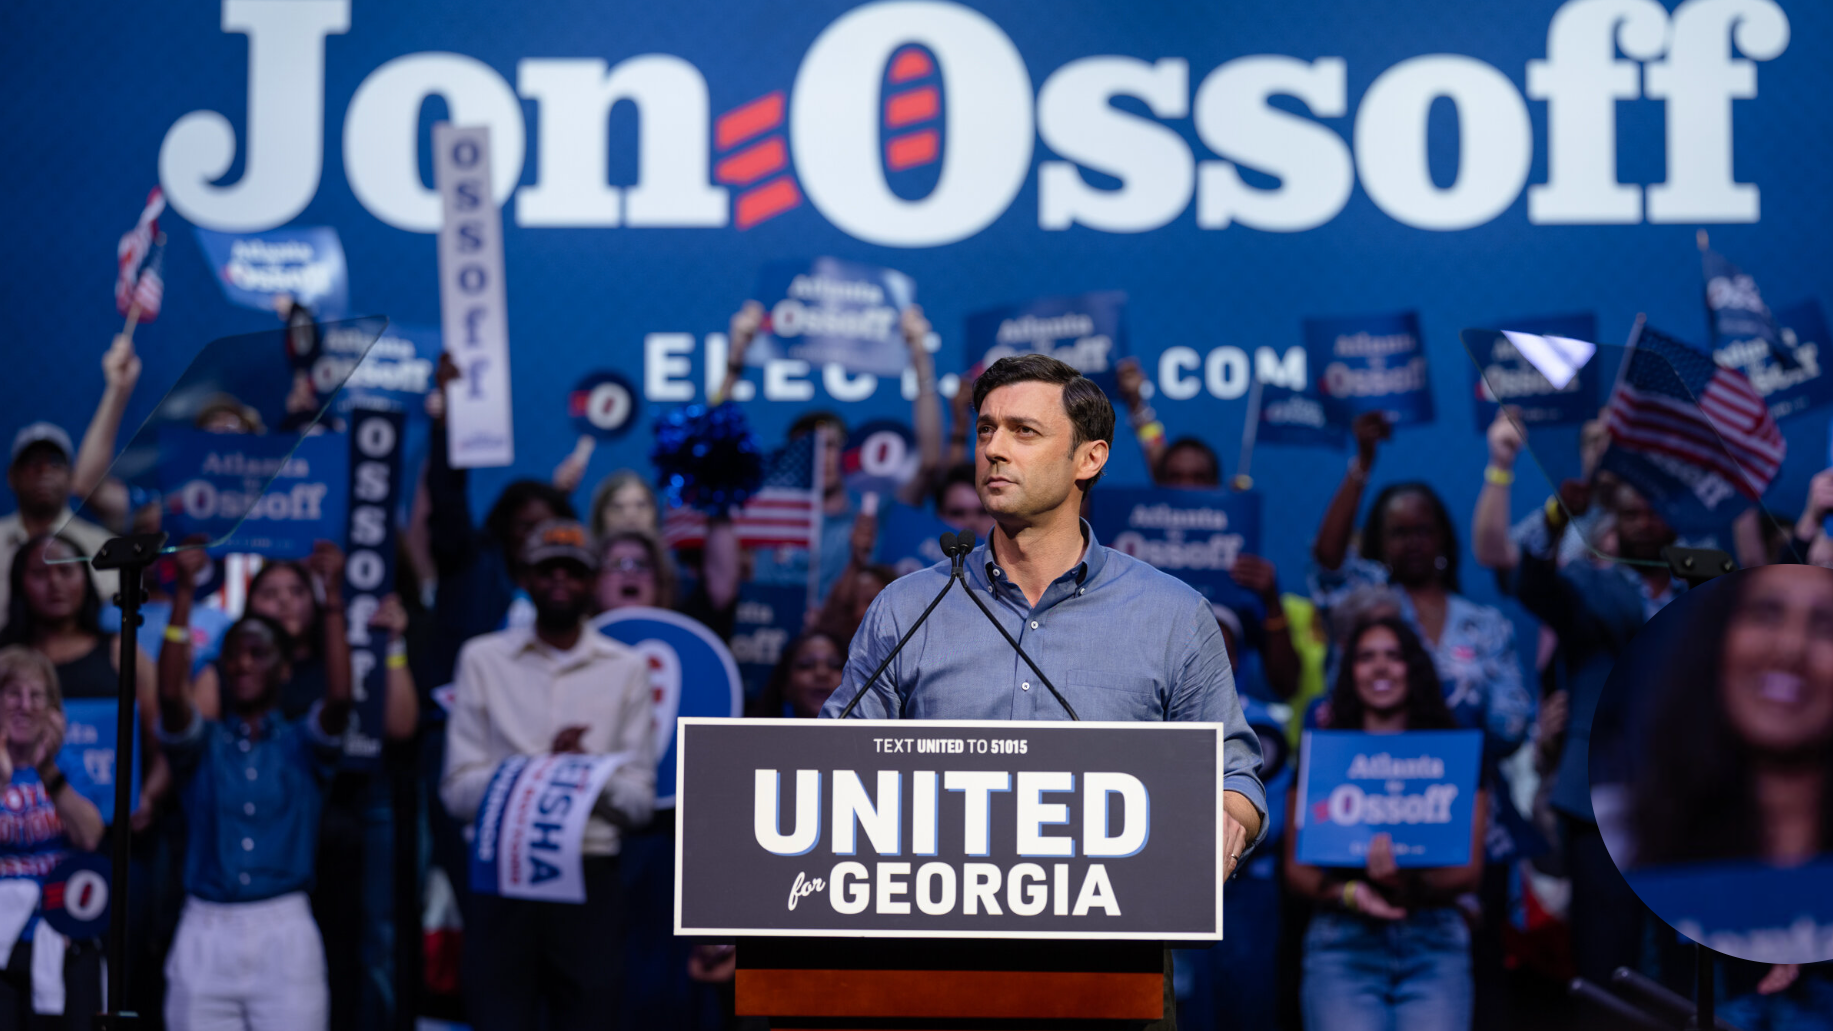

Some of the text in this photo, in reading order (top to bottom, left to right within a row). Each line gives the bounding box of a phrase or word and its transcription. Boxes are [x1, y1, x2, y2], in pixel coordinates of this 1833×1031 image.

[158, 0, 1791, 248] Jon Ossoff
[182, 479, 328, 520] Ossoff
[874, 738, 1028, 755] TEXT UNITED TO 51015
[1348, 752, 1445, 780] Atlanta
[754, 769, 1151, 858] UNITED
[1329, 783, 1459, 827] Ossoff
[787, 860, 1122, 917] for GEORGIA
